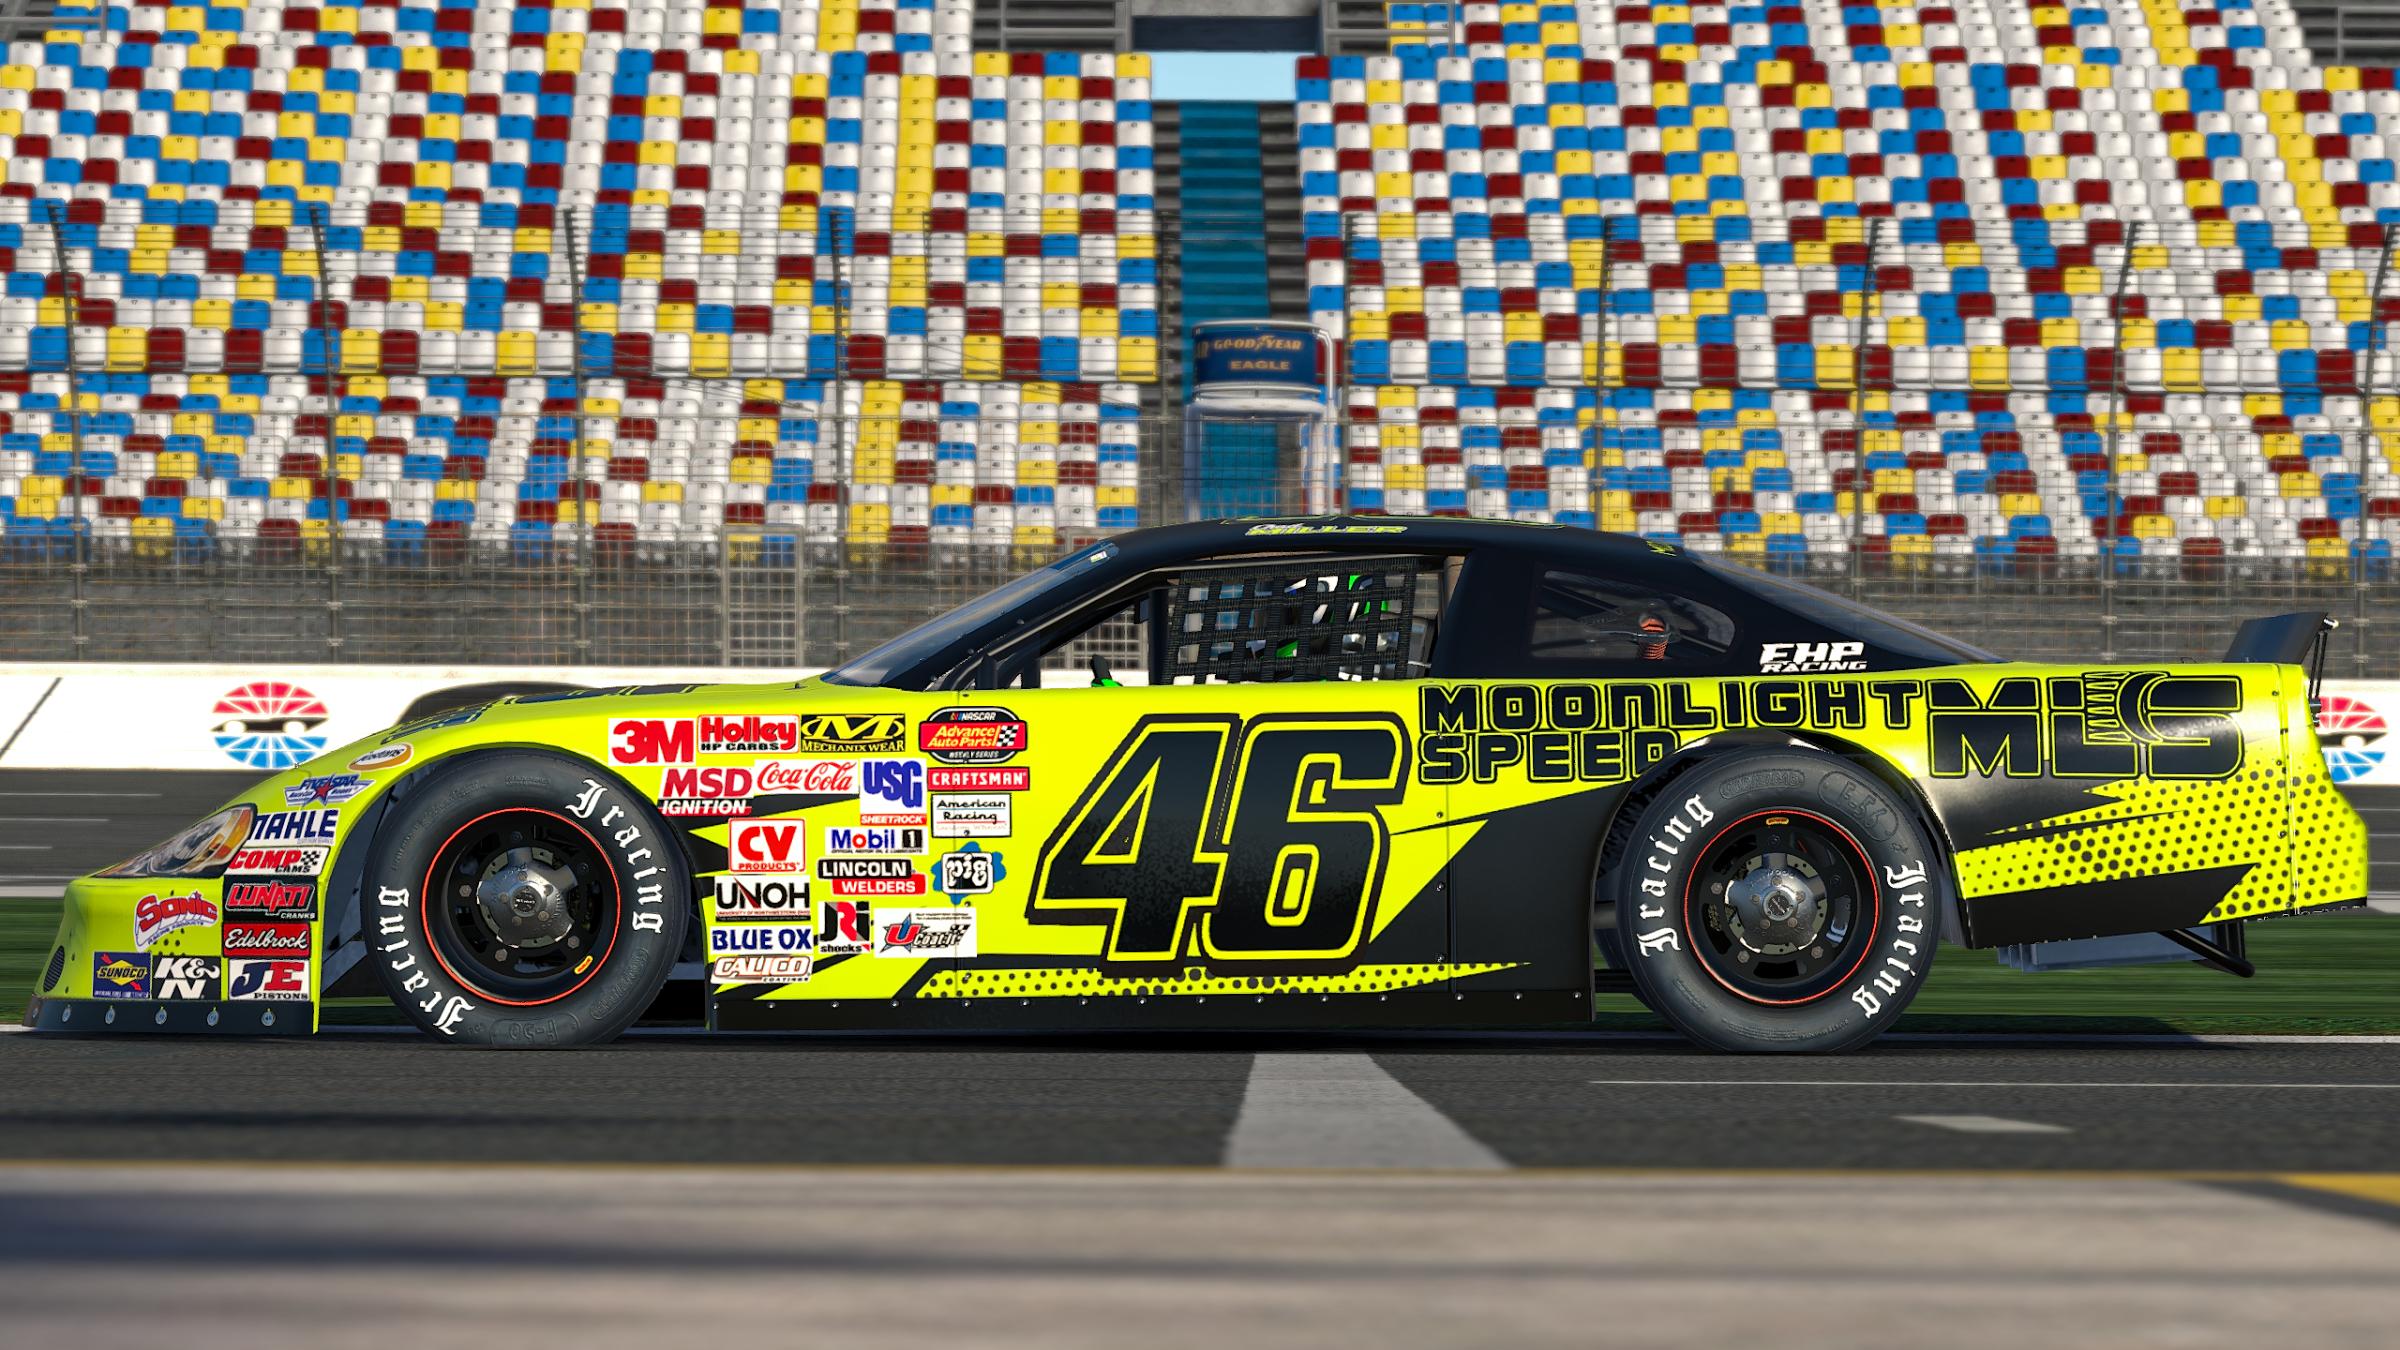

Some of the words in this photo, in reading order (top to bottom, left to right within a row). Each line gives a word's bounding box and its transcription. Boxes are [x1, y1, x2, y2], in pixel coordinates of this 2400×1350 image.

[1229, 360, 1290, 370] EAGLE
[1760, 661, 1867, 673] RACING
[1419, 680, 1919, 733] MOONLIGHT
[961, 712, 996, 721] NASCAR
[701, 717, 797, 750] Holley
[935, 725, 995, 737] Advance
[612, 720, 694, 763] 3M
[725, 743, 779, 751] CARBS
[802, 740, 866, 752] MECHANIX
[869, 740, 905, 751] WEAR
[928, 738, 957, 747] Auto
[959, 738, 993, 747] Parts
[1419, 730, 1681, 783] SPEED
[300, 778, 329, 790] FIVE
[331, 774, 360, 787] STAR
[663, 768, 753, 799] MSD
[863, 760, 923, 808] USG
[932, 772, 1026, 786] CRAFTSMAN
[662, 800, 748, 815] IGNITION
[936, 799, 1006, 808] American
[861, 815, 924, 824] SHEETROCK
[943, 811, 998, 825] Racing
[737, 826, 797, 861] CV
[831, 829, 895, 849] Mobil
[1026, 712, 1412, 977] 46
[229, 850, 302, 870] COMP
[275, 864, 311, 873] CAMS
[738, 862, 797, 870] PRODUCTS
[822, 861, 907, 877] LINCOLN
[946, 854, 992, 887] pig
[716, 880, 810, 909] UNOH
[842, 880, 916, 893] WELDERS
[226, 881, 311, 913] LUNATI
[136, 894, 218, 932] SONIC
[224, 928, 309, 949] Edelbrock
[712, 929, 773, 950] BLUE
[778, 928, 812, 950] OX
[886, 923, 922, 946] U
[820, 944, 862, 952] shocks
[99, 967, 147, 979] SUNOCO
[714, 956, 811, 977] CALICO
[231, 961, 305, 997] JE
